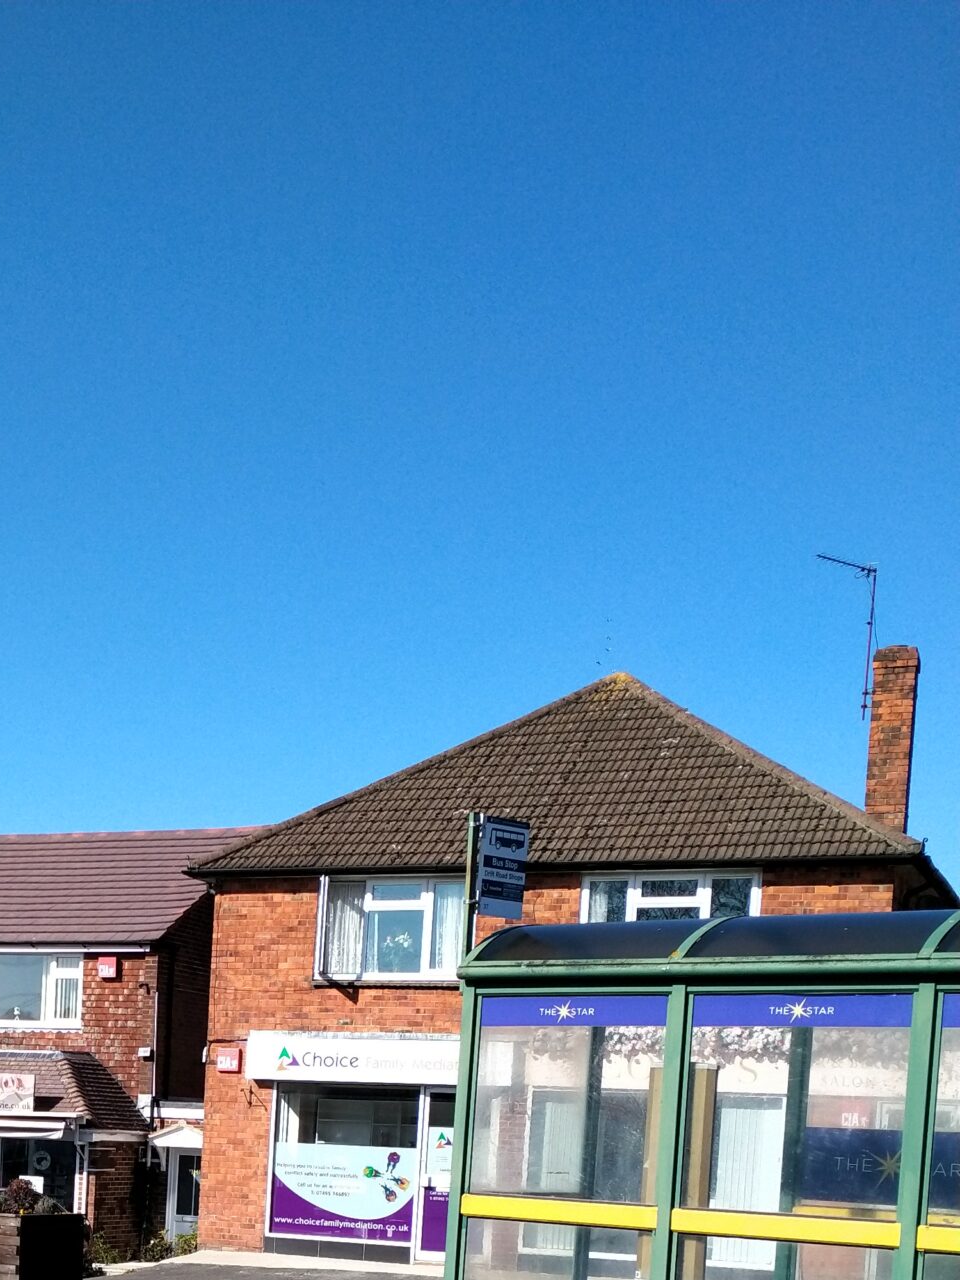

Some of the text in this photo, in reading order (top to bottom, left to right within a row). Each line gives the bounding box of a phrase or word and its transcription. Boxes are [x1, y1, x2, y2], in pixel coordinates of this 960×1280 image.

[492, 857, 519, 869] Bus Stop
[496, 871, 508, 879] Road
[509, 873, 523, 882] Shops
[540, 1007, 595, 1017] THE STAR
[769, 1005, 835, 1016] THE STAR
[302, 1051, 359, 1068] Choice
[365, 1057, 405, 1071] Family
[841, 1112, 859, 1127] CIA
[834, 1156, 873, 1172] THE
[274, 1216, 409, 1232] www.choicefamilymediation.co.uk
